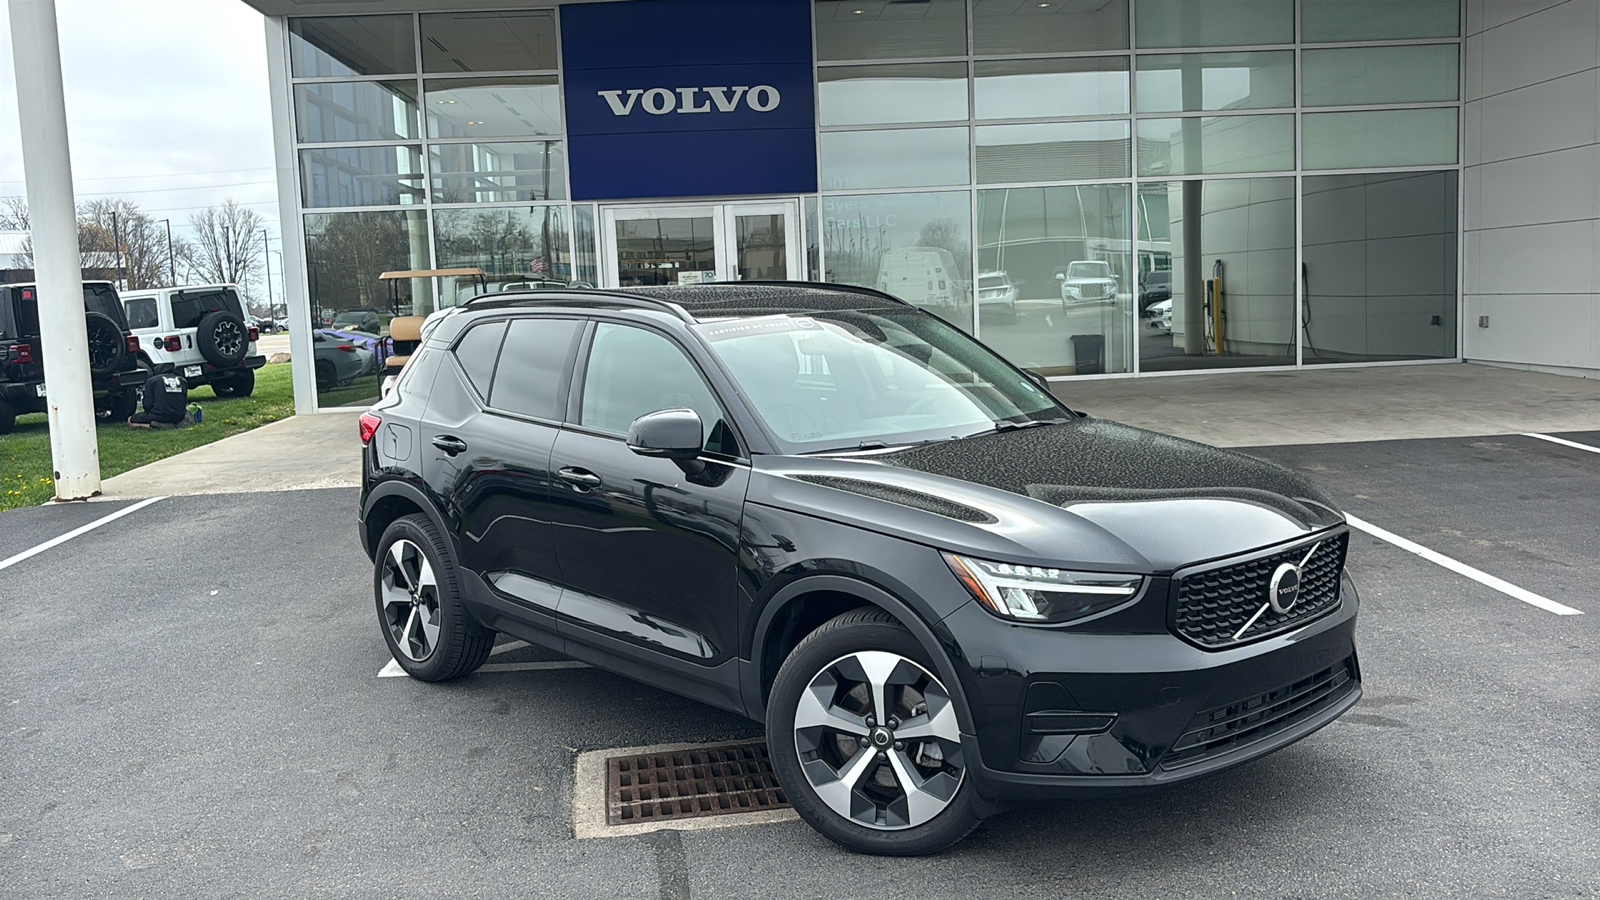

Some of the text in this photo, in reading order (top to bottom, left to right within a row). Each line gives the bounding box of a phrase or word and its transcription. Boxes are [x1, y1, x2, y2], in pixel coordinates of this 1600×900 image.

[597, 85, 781, 116] VOLVO
[825, 198, 868, 213] Byers
[1279, 585, 1298, 594] VOLVO
